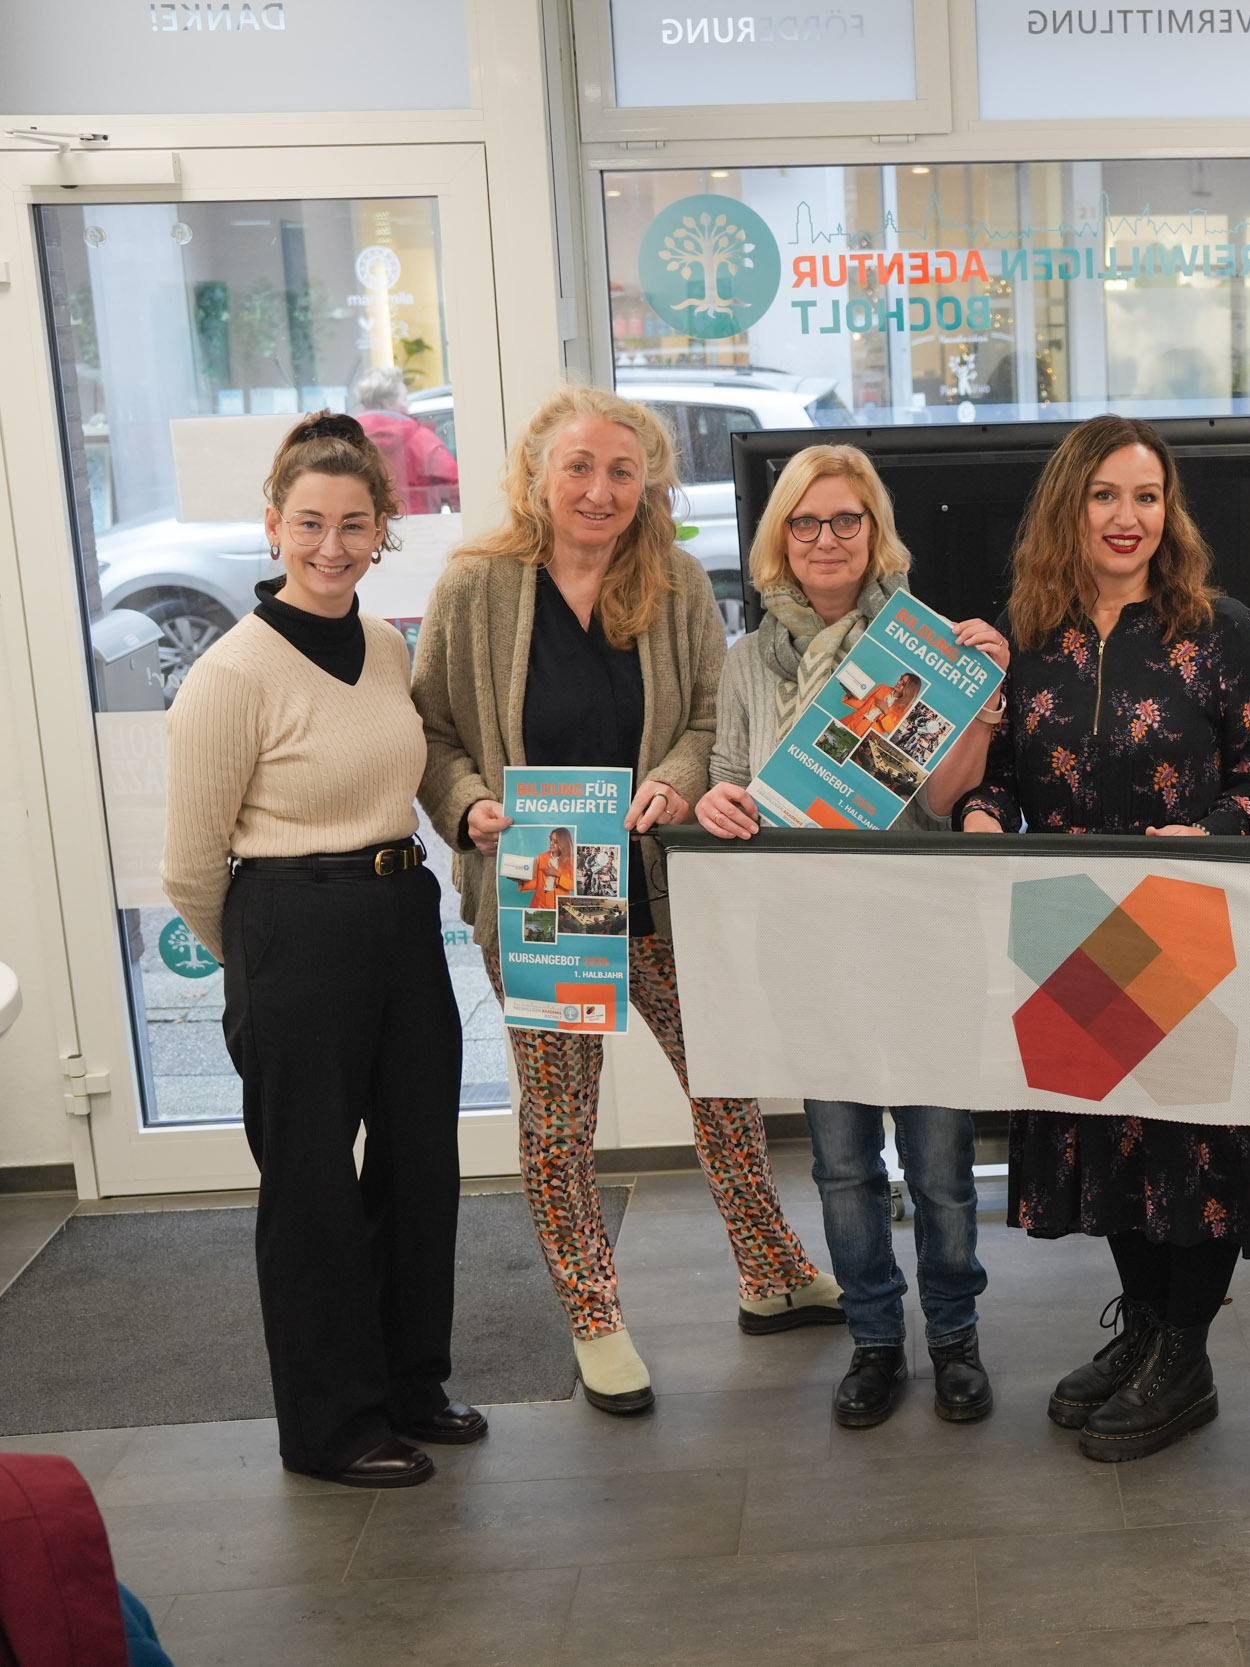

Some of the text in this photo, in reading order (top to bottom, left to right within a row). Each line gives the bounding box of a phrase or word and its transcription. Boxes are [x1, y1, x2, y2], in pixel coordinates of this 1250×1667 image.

[894, 607, 989, 687] BILDUNG FÜR
[884, 620, 981, 699] ENGAGIERTE
[787, 743, 878, 816] KURSANGEBOT 2026
[517, 780, 618, 797] BILDUNG FÜR
[515, 798, 618, 814] ENGAGIERTE
[508, 951, 610, 967] KURSANGEBOT 2026
[574, 970, 624, 979] 1. HALBJAHR
